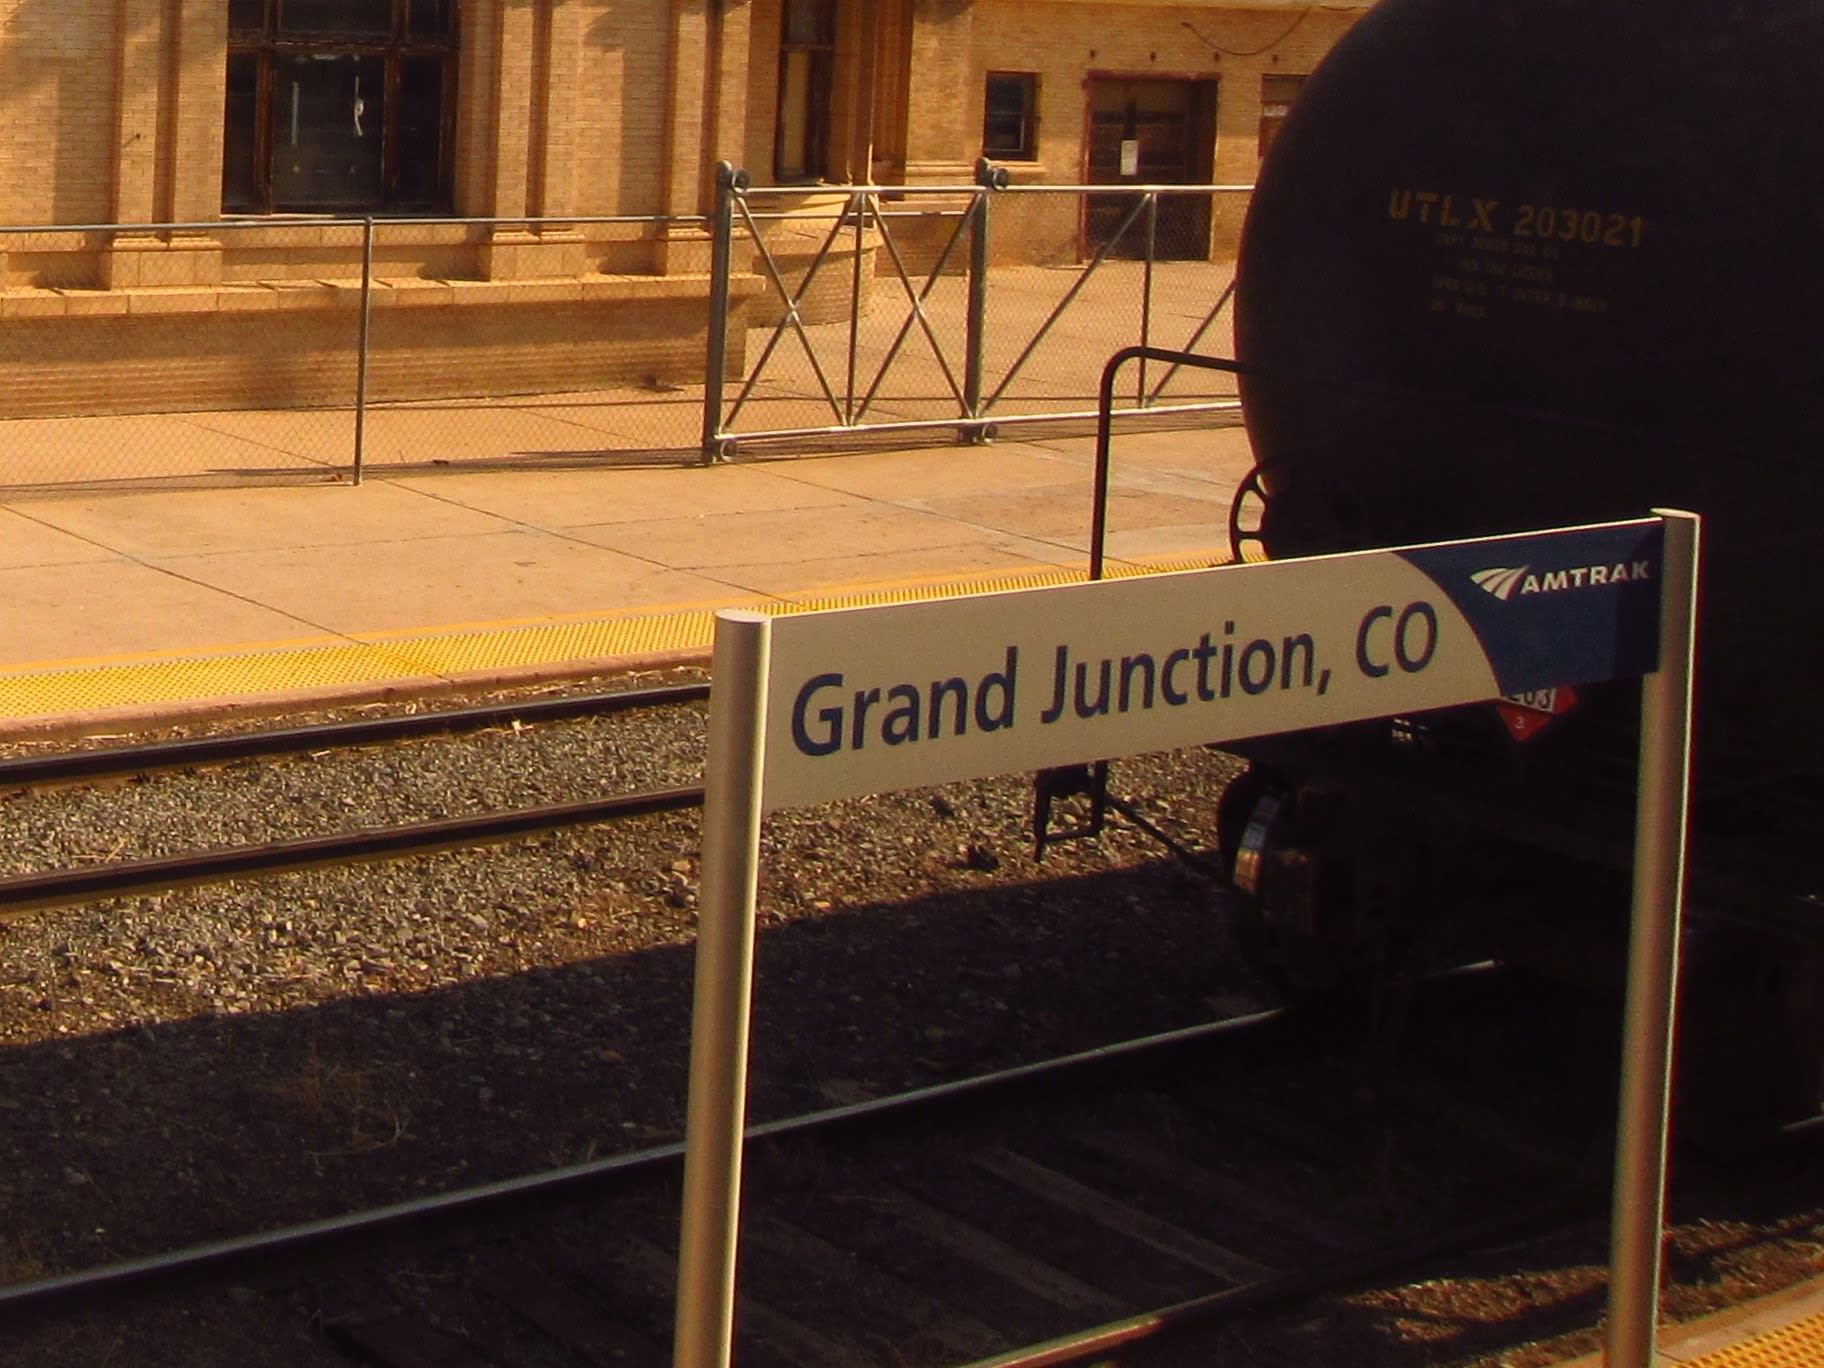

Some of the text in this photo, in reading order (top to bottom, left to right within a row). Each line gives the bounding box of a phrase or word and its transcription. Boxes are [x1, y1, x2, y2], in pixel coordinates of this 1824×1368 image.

[1513, 203, 1645, 249] 203021
[1520, 560, 1650, 598] AMTRAK
[790, 600, 1439, 758] Grand Junction, CO
